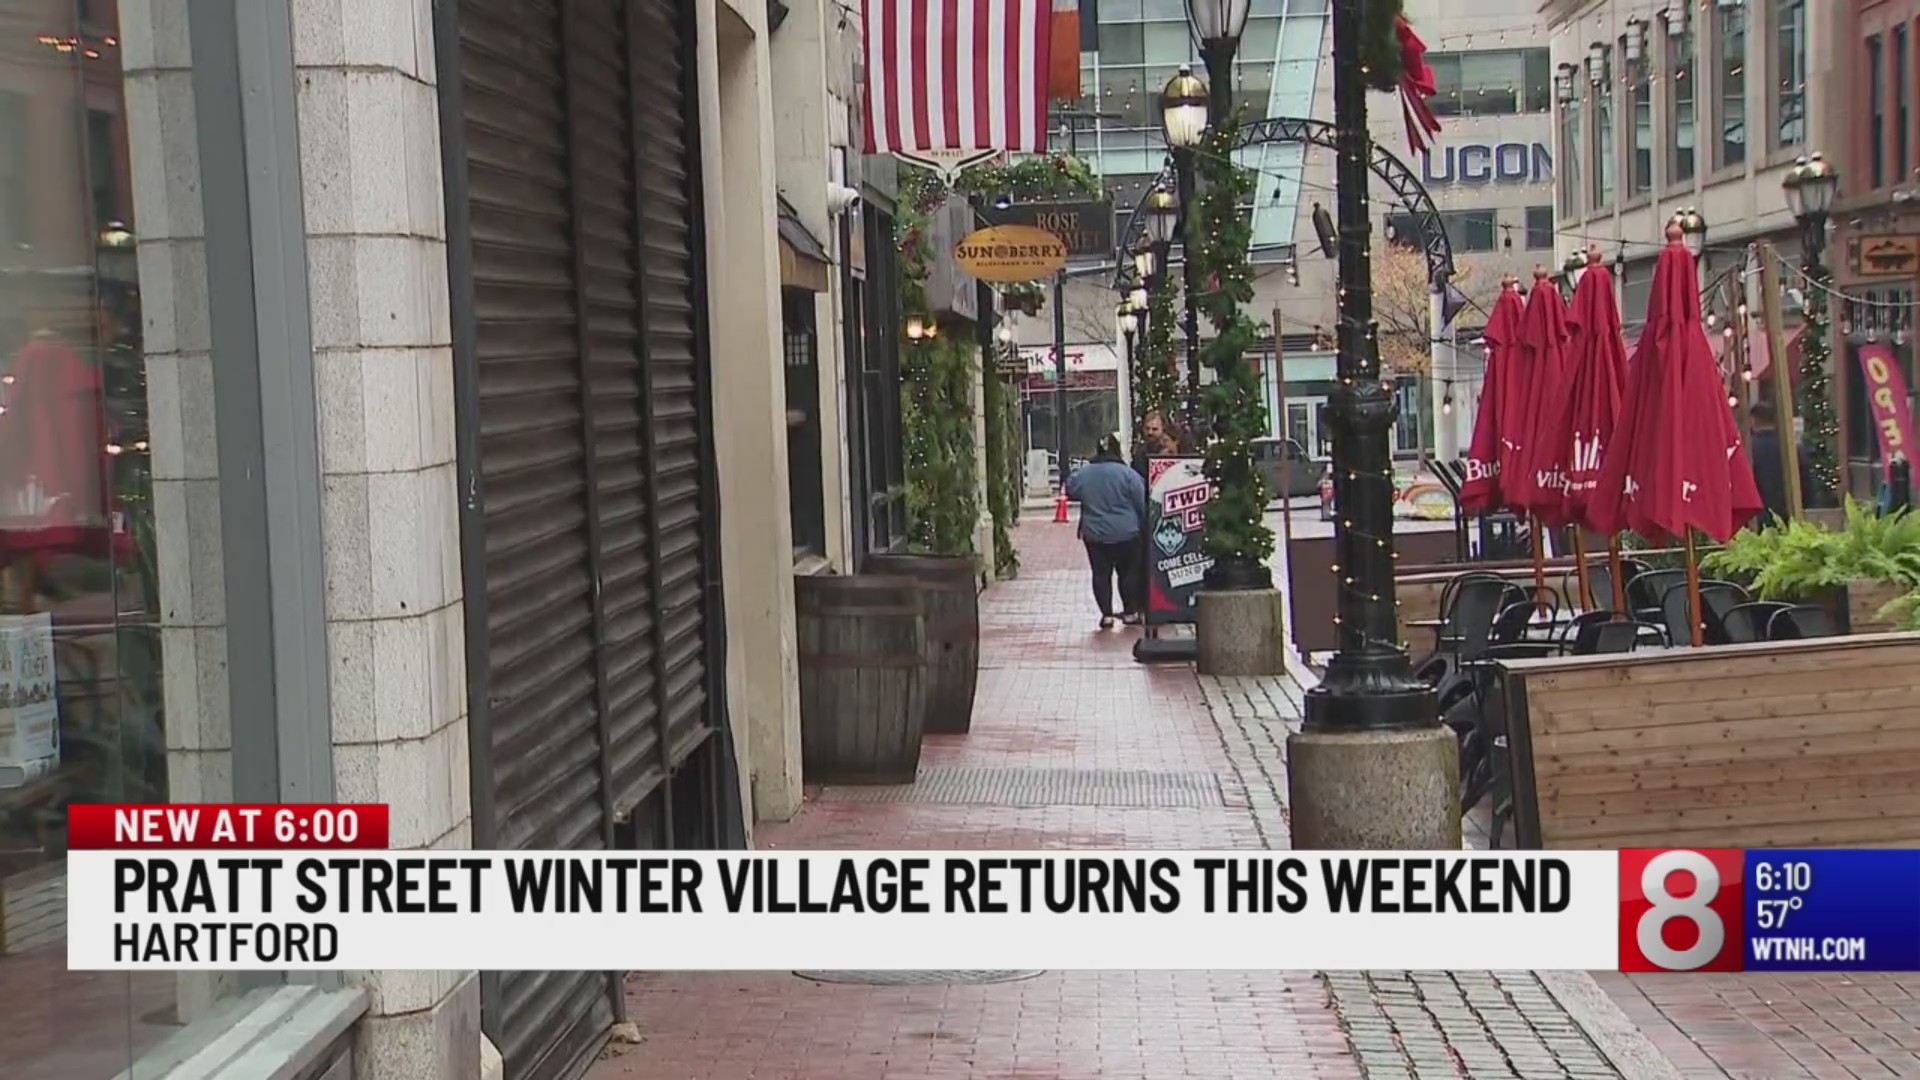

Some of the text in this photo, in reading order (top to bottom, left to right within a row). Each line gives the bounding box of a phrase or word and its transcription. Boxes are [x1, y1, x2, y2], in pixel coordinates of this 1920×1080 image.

[1036, 211, 1081, 232] ROSE
[1167, 486, 1207, 509] TWO
[1157, 555, 1183, 572] COME
